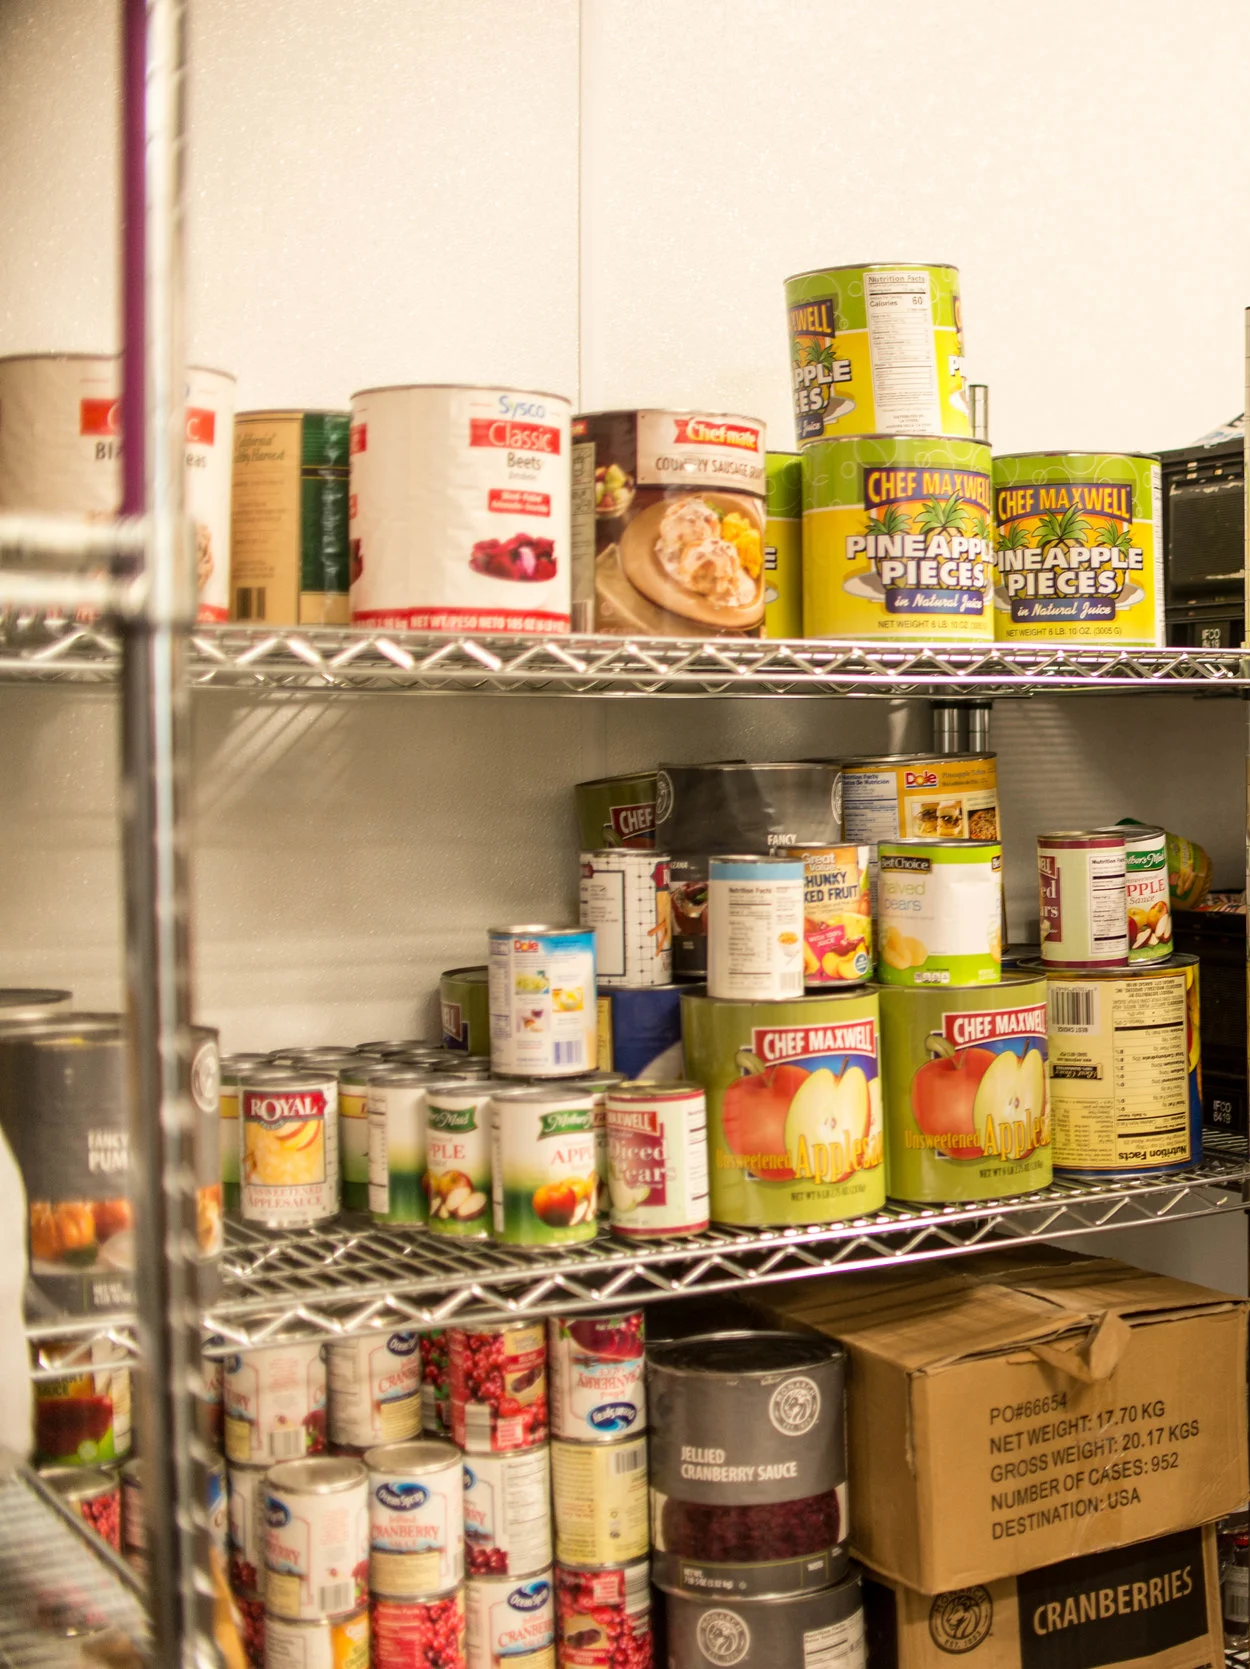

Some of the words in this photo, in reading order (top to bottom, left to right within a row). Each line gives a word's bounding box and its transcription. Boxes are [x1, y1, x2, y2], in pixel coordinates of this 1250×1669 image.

[912, 297, 923, 305] 60
[498, 395, 545, 418] Sysco
[489, 422, 552, 452] Classic
[507, 451, 542, 470] Beets
[868, 471, 917, 503] CHEF
[923, 471, 990, 508] MAXWELL
[998, 488, 1035, 521] CHEF
[1040, 487, 1130, 518] MAXWELL
[881, 560, 984, 587] PIECES
[1008, 571, 1116, 596] PIECES
[894, 596, 909, 607] in
[912, 594, 958, 608] Natural
[959, 594, 983, 612] Juice
[1018, 606, 1029, 616] in
[1031, 603, 1077, 616] Natural
[1079, 602, 1112, 618] Juice
[878, 620, 895, 629] NET
[896, 620, 929, 629] WEIGHT
[1006, 629, 1018, 637] NET
[1018, 628, 1046, 636] WEIGHT
[905, 771, 937, 786] Dole
[619, 808, 653, 834] CHEF
[767, 834, 797, 845] FANCY
[804, 872, 847, 888] HUNKY
[1127, 879, 1165, 897] PPLE
[828, 885, 858, 900] FRUIT
[514, 940, 539, 951] Dole
[953, 1016, 992, 1043] CHEF
[996, 1010, 1046, 1034] MAXWELL
[763, 1030, 805, 1060] CHEF
[808, 1025, 872, 1051] MAXWELL
[251, 1097, 317, 1121] ROYAL
[1213, 1101, 1231, 1112] IFCO
[904, 1128, 981, 1149] Unsweetened
[715, 1146, 792, 1169] Unsweetened
[1118, 1150, 1147, 1161] Facts
[1148, 1144, 1187, 1159] Nutrition
[990, 1392, 1068, 1425] PO#66654
[990, 1436, 1024, 1455] NET
[1027, 1415, 1093, 1450] WEIGHT:
[1097, 1407, 1137, 1430] 17.70
[1141, 1401, 1165, 1422] KG
[681, 1445, 727, 1465] JELLIED
[991, 1455, 1049, 1483] GROSS
[1052, 1437, 1118, 1467] WEIGHT:
[1122, 1428, 1164, 1451] 20.17
[1168, 1420, 1200, 1441] KGS
[681, 1464, 756, 1483] CRANBERRY
[757, 1461, 798, 1481] SAUCE
[991, 1480, 1060, 1511] NUMBER
[1063, 1471, 1085, 1492] OF
[1088, 1459, 1148, 1486] CASES:
[1151, 1452, 1179, 1473] 952
[992, 1498, 1104, 1540] DESTINATION:
[1107, 1487, 1141, 1511] USA
[372, 1525, 440, 1540] CRANBERRY
[1033, 1564, 1193, 1636] CRANBERRIES
